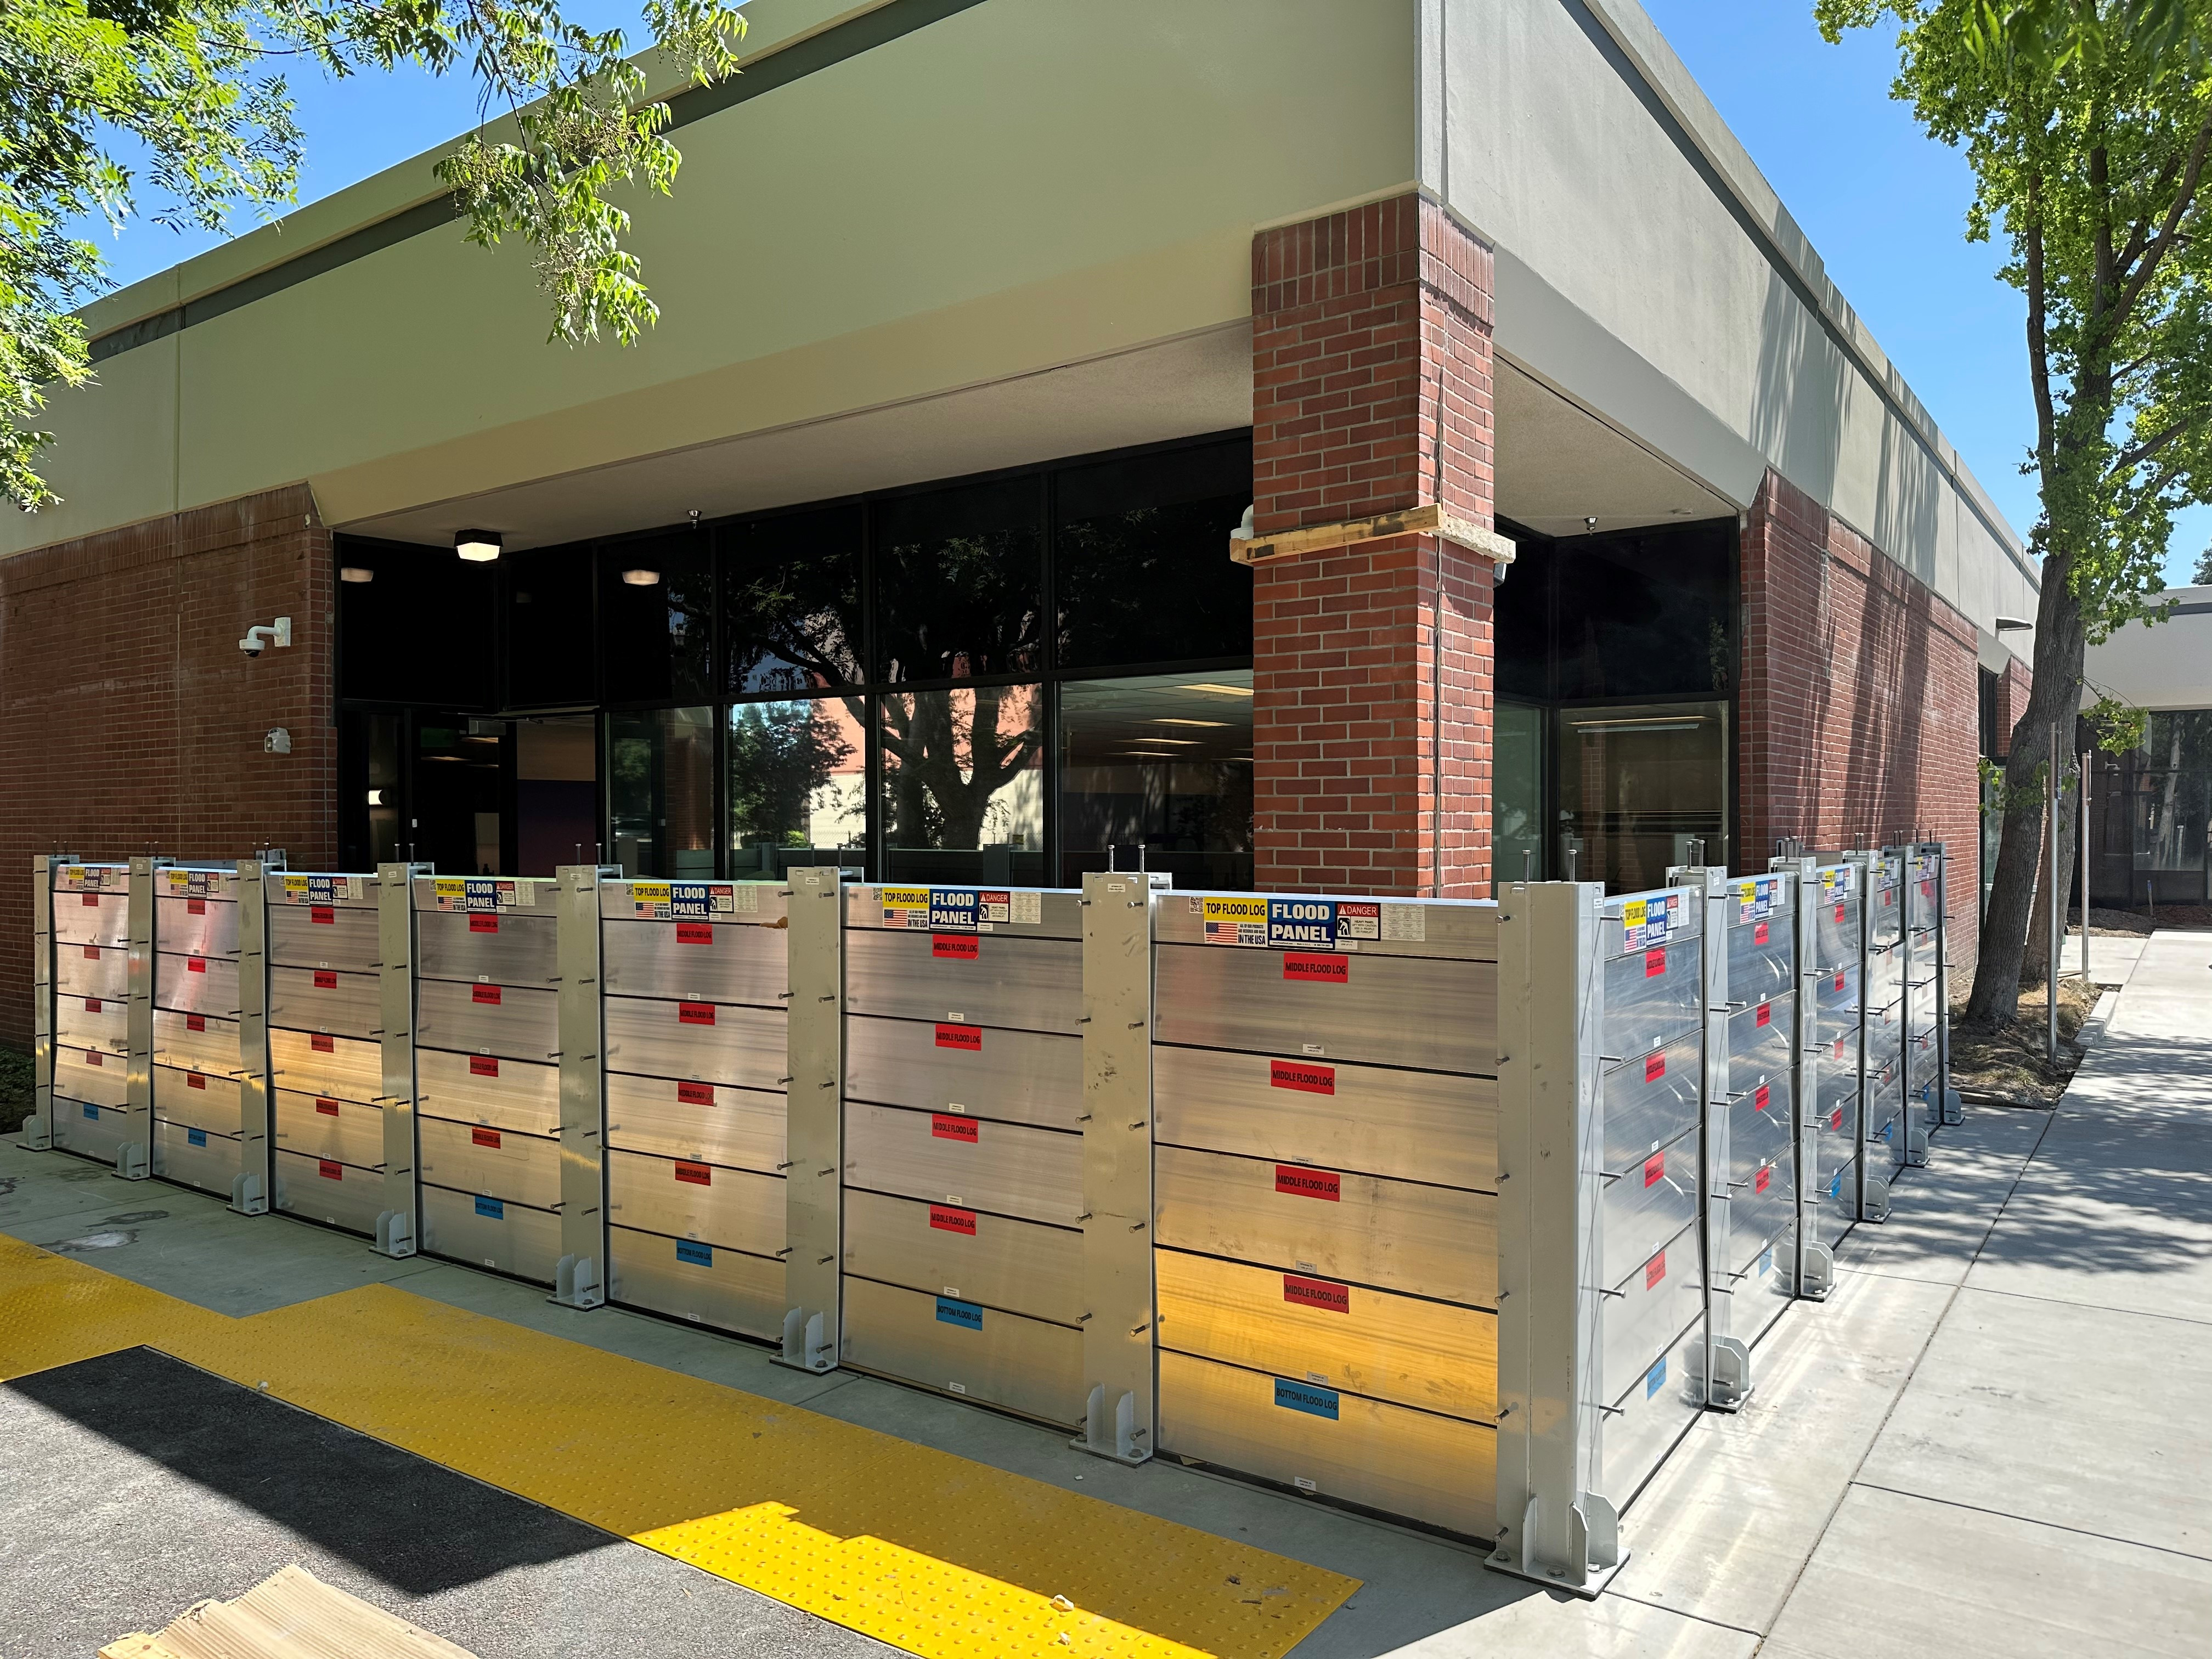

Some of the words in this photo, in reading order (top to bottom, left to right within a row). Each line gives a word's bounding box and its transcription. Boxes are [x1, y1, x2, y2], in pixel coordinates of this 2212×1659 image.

[189, 873, 205, 882] FLOOD
[309, 879, 330, 888] FLOOD
[189, 885, 205, 893] PANEL
[467, 883, 493, 893] FLOOD
[635, 888, 644, 896] TOP
[645, 888, 659, 896] FLOOD
[661, 888, 669, 896] LOG
[673, 887, 706, 899] FLOOD
[1756, 884, 1768, 896] FLOOD
[310, 891, 331, 900] PANEL
[885, 893, 895, 902] TOP
[897, 893, 915, 903] FLOOD
[916, 894, 928, 903] LOG
[933, 893, 974, 906] FLOOD
[467, 898, 494, 907] PANEL
[673, 903, 707, 915] PANEL
[1206, 902, 1221, 914] TOP
[1223, 904, 1248, 915] FLOOD
[1250, 904, 1265, 916] LOG
[1756, 900, 1768, 913] PANEL
[1272, 904, 1330, 920] FLOOD
[1347, 906, 1377, 916] DANGER
[1647, 901, 1664, 918] FLOOD
[932, 911, 975, 924] PANEL
[1272, 924, 1331, 941] PANEL
[1647, 921, 1665, 938] PANEL
[1238, 934, 1244, 943] IN
[1244, 935, 1254, 944] THE
[1255, 935, 1265, 945] USA
[934, 943, 951, 951] MIDDLE
[951, 944, 967, 952] FLOOD
[968, 944, 977, 952] LOG
[1285, 962, 1309, 973] MIDDLE
[1310, 963, 1331, 974] FLOOD
[1333, 965, 1346, 975] LOG
[937, 1032, 953, 1041] MIDDLE
[955, 1034, 969, 1043] FLOOD
[970, 1035, 980, 1044] LOG
[1272, 1070, 1296, 1081] MIDDLE
[1297, 1073, 1318, 1084] FLOOD
[1319, 1076, 1333, 1087] LOG
[934, 1122, 950, 1132] MIDDLE
[951, 1124, 966, 1134] FLOOD
[967, 1126, 977, 1136] LOG
[1277, 1174, 1301, 1187] MIDDLE
[1302, 1178, 1323, 1190] FLOOD
[1324, 1182, 1338, 1193] LOG
[931, 1213, 948, 1223] MIDDLE
[949, 1216, 964, 1226] FLOOD
[964, 1218, 974, 1228] LOG
[1285, 1284, 1310, 1297] MIDDLE
[1311, 1289, 1332, 1302] FLOOD
[1333, 1293, 1347, 1305] LOG
[938, 1305, 956, 1316] BOTTOM
[957, 1310, 971, 1320] FLOOD
[972, 1314, 981, 1322] LOG
[1276, 1387, 1302, 1401] BOTTOM
[1303, 1394, 1323, 1407] FLOOD
[1324, 1400, 1337, 1410] LOG
